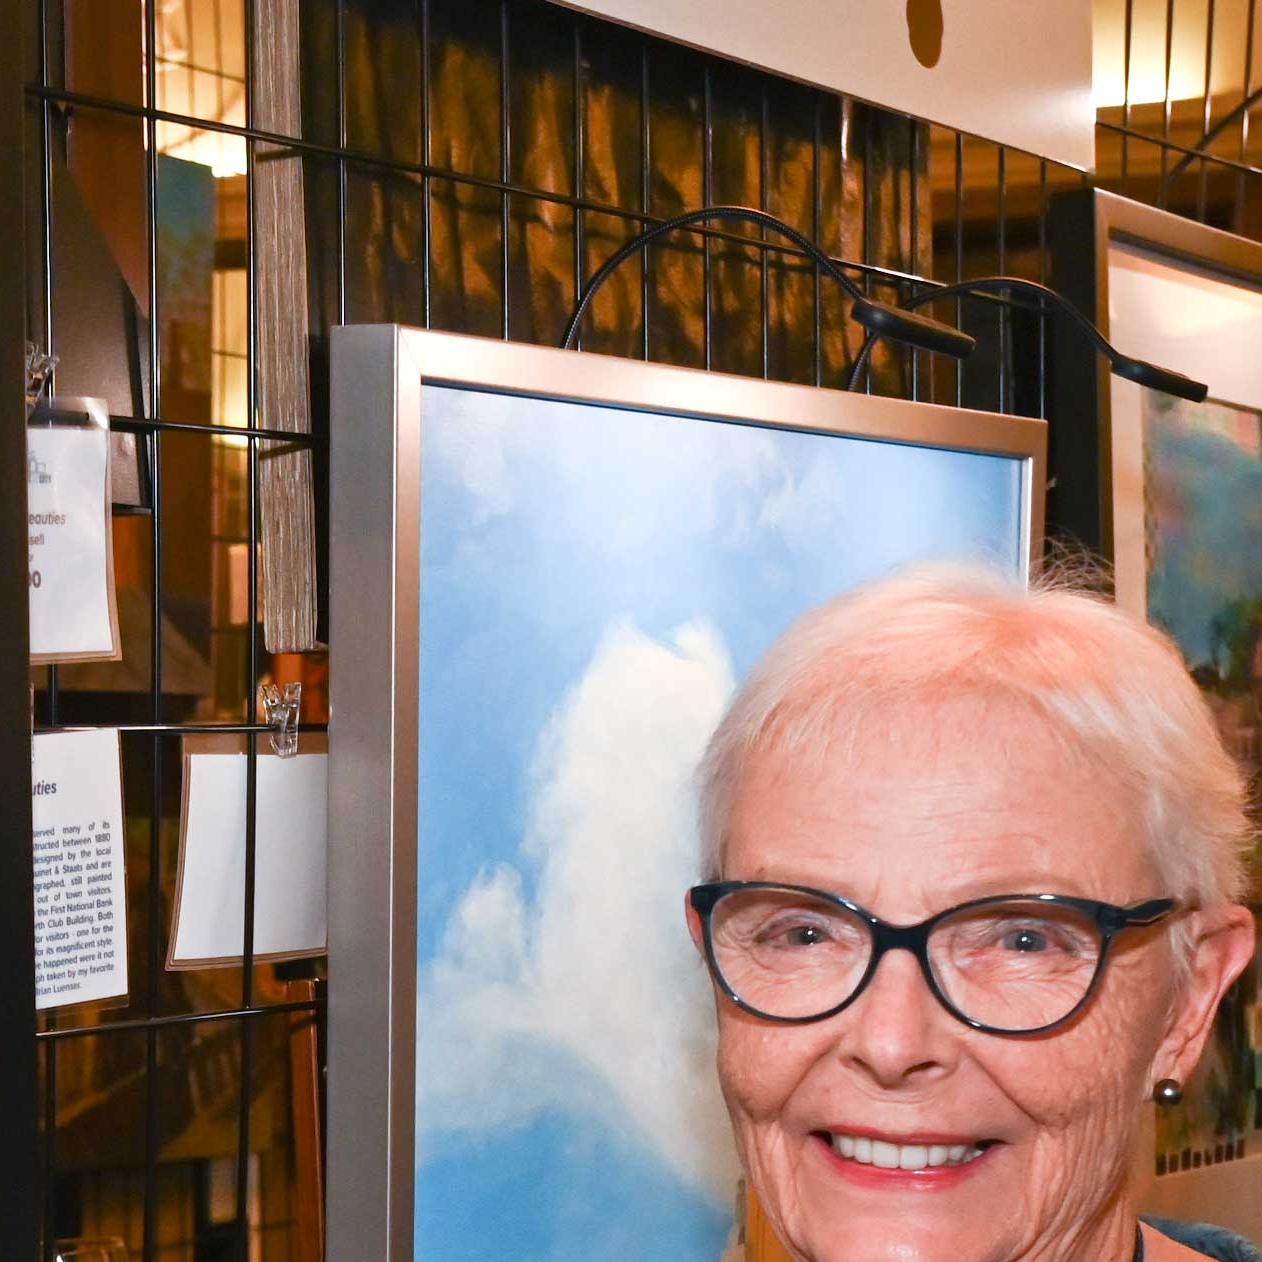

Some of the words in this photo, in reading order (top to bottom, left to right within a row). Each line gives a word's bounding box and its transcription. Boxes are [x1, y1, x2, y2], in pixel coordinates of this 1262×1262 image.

[63, 837, 91, 847] between
[68, 852, 76, 861] by
[80, 850, 91, 858] the
[86, 861, 98, 870] and
[87, 872, 112, 885] painted
[37, 895, 49, 903] out
[54, 892, 61, 901] of
[66, 891, 82, 899] town
[51, 905, 65, 914] First
[67, 901, 94, 912] National
[96, 898, 113, 908] Bank
[48, 918, 64, 928] Club
[98, 911, 113, 921] Both
[46, 932, 69, 942] visitors
[103, 924, 113, 933] the
[56, 941, 95, 954] magnificent
[44, 955, 78, 969] happened
[80, 954, 95, 962] were
[103, 950, 114, 958] not
[46, 971, 66, 981] taken
[67, 969, 76, 979] by
[89, 963, 114, 974] favorite
